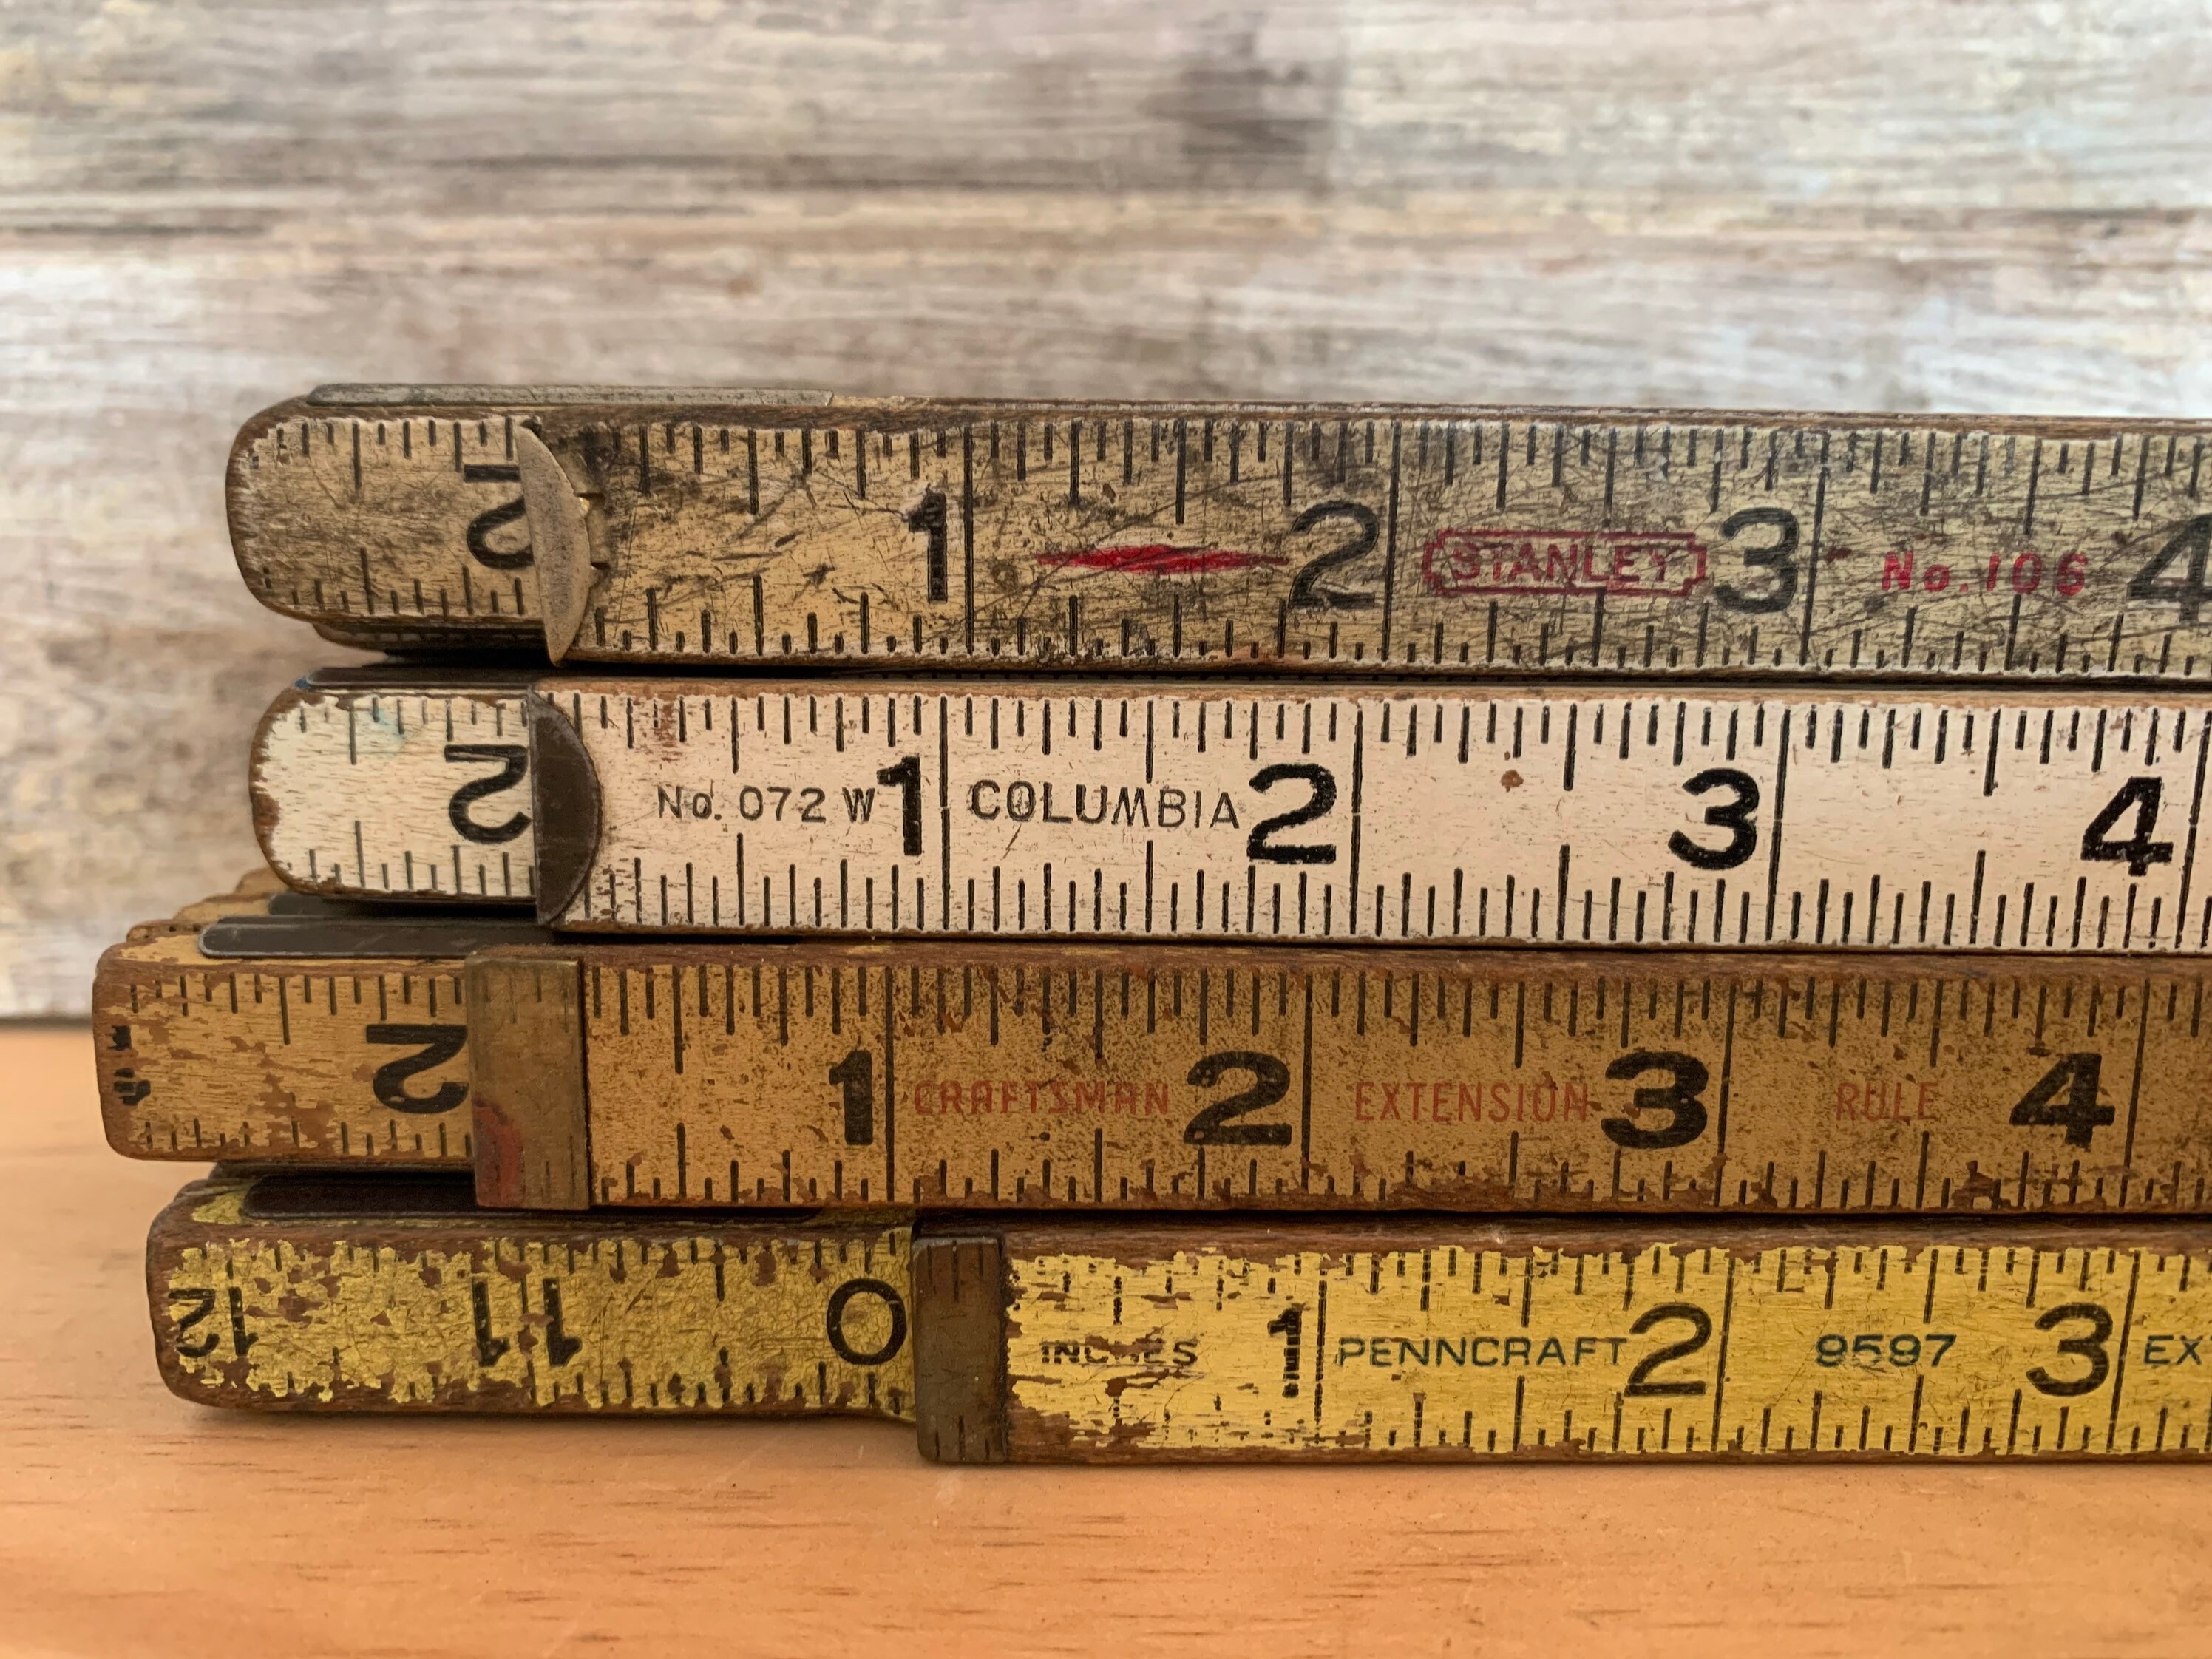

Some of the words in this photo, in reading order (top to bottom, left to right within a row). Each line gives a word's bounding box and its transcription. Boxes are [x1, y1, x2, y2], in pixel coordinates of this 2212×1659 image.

[906, 489, 948, 603] 1
[1288, 501, 1380, 608] 2
[1453, 542, 1683, 583] STANLEY
[1714, 506, 1800, 614] 3
[2126, 513, 2212, 622] 4
[444, 744, 532, 844] 2
[657, 784, 722, 822] No.
[739, 786, 827, 824] 072
[842, 787, 875, 824] W
[876, 755, 922, 857] 1
[969, 778, 1241, 830] COLUMBIA
[1246, 762, 1337, 864] 2
[1667, 767, 1761, 871] 3
[2080, 776, 2174, 877] 4
[366, 1023, 469, 1114] 2
[829, 1050, 874, 1146] 1
[913, 1079, 1170, 1116] CRAFTSMAN
[1183, 1051, 1293, 1146] 2
[1354, 1080, 1589, 1123] EXTENSION
[1600, 1051, 1709, 1150] 3
[1834, 1080, 1938, 1123] RULE
[2009, 1053, 2115, 1148] 4
[471, 1277, 583, 1368] 11
[1267, 1306, 1303, 1399] 1
[1336, 1334, 1628, 1369] PENNCRAFT
[1624, 1302, 1713, 1397] 2
[1815, 1333, 1958, 1368] 9597
[2025, 1302, 2114, 1397] 3
